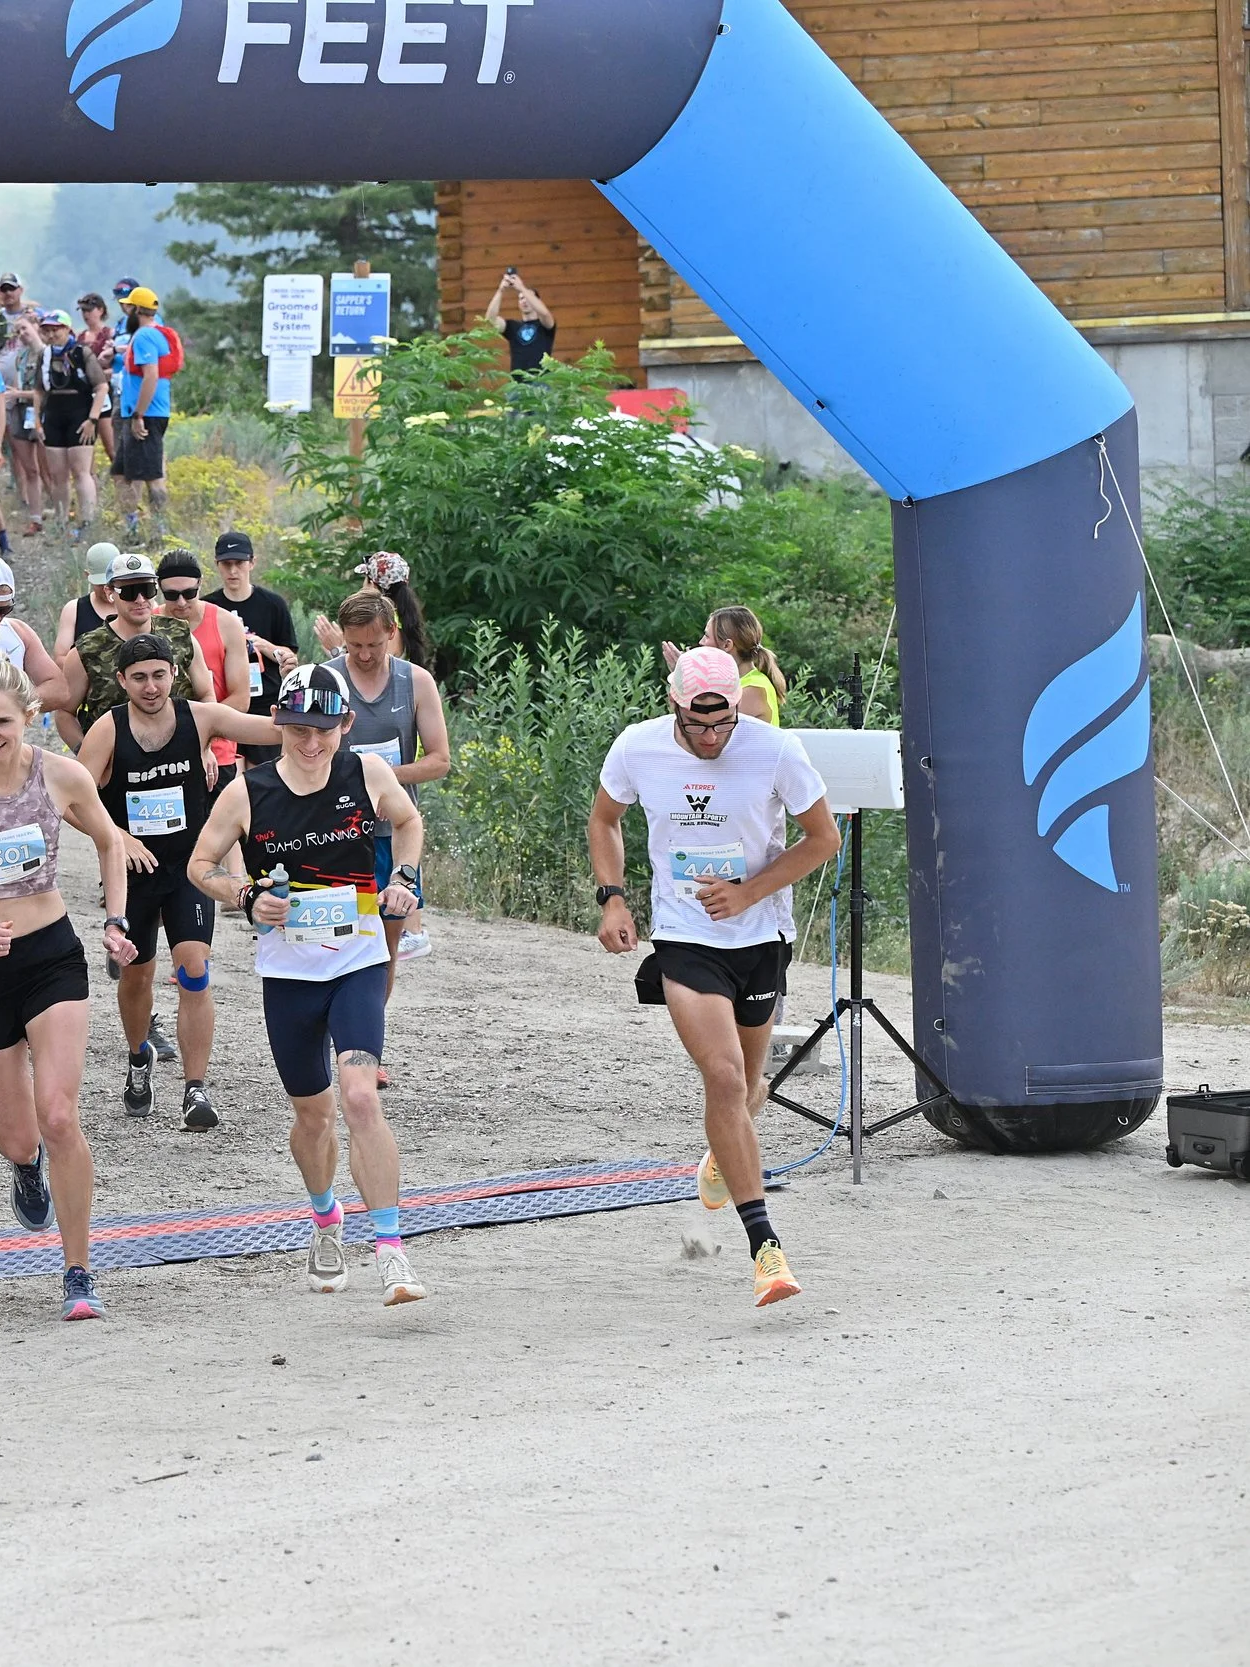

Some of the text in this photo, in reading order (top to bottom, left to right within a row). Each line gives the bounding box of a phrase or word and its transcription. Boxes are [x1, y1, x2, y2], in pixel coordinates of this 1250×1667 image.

[217, 0, 534, 84] FEET
[335, 295, 373, 305] SAPPER'S
[268, 302, 318, 311] Groomed
[335, 305, 366, 316] RETURN
[282, 312, 303, 320] Trail
[273, 322, 311, 332] System
[138, 802, 176, 819] 445
[336, 802, 356, 810] SUGOI
[704, 813, 728, 822] SPORTS
[264, 838, 302, 854] IDAHO
[306, 828, 358, 846] RUNNING
[684, 860, 734, 877] 444
[298, 904, 345, 926] 426
